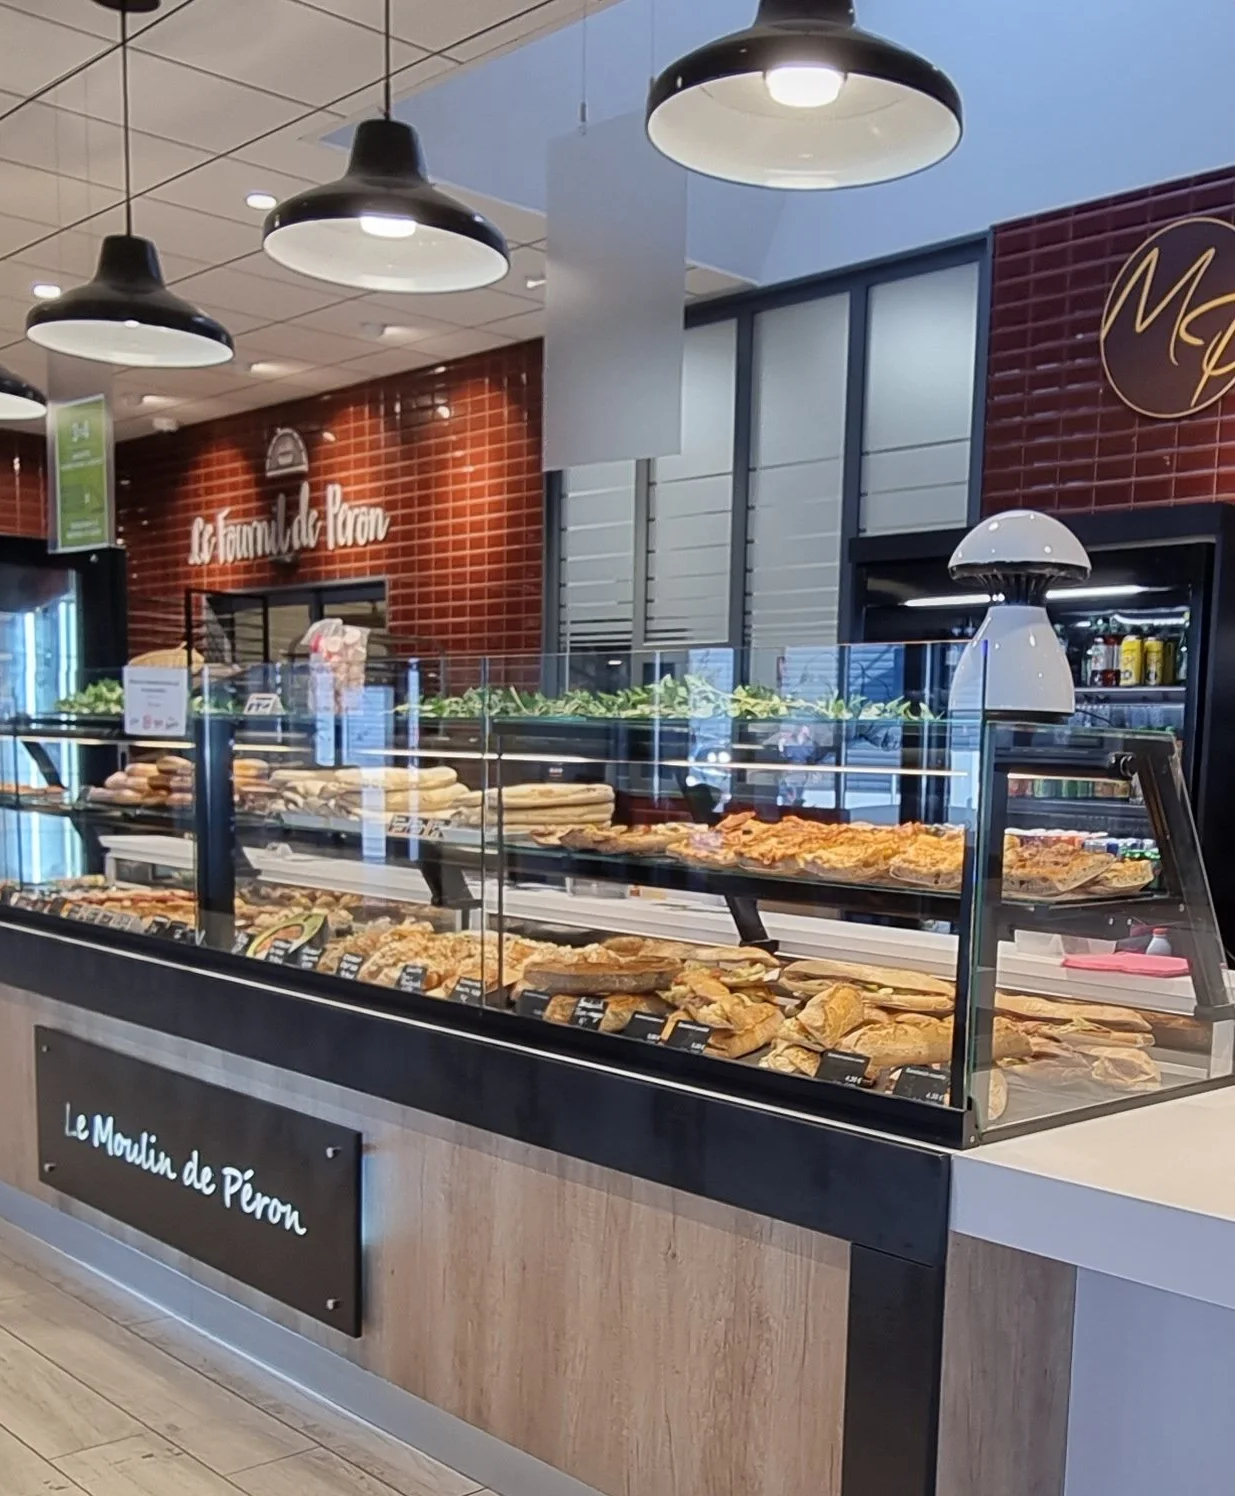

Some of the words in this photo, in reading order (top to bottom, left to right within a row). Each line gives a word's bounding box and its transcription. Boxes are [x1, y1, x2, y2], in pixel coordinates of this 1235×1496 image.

[188, 516, 217, 565] Le
[217, 492, 291, 565] Fournil
[292, 480, 323, 551] de
[64, 1101, 90, 1142] Le
[92, 1113, 178, 1181] Moulin
[181, 1149, 216, 1196] de
[221, 1165, 308, 1236] Péron
